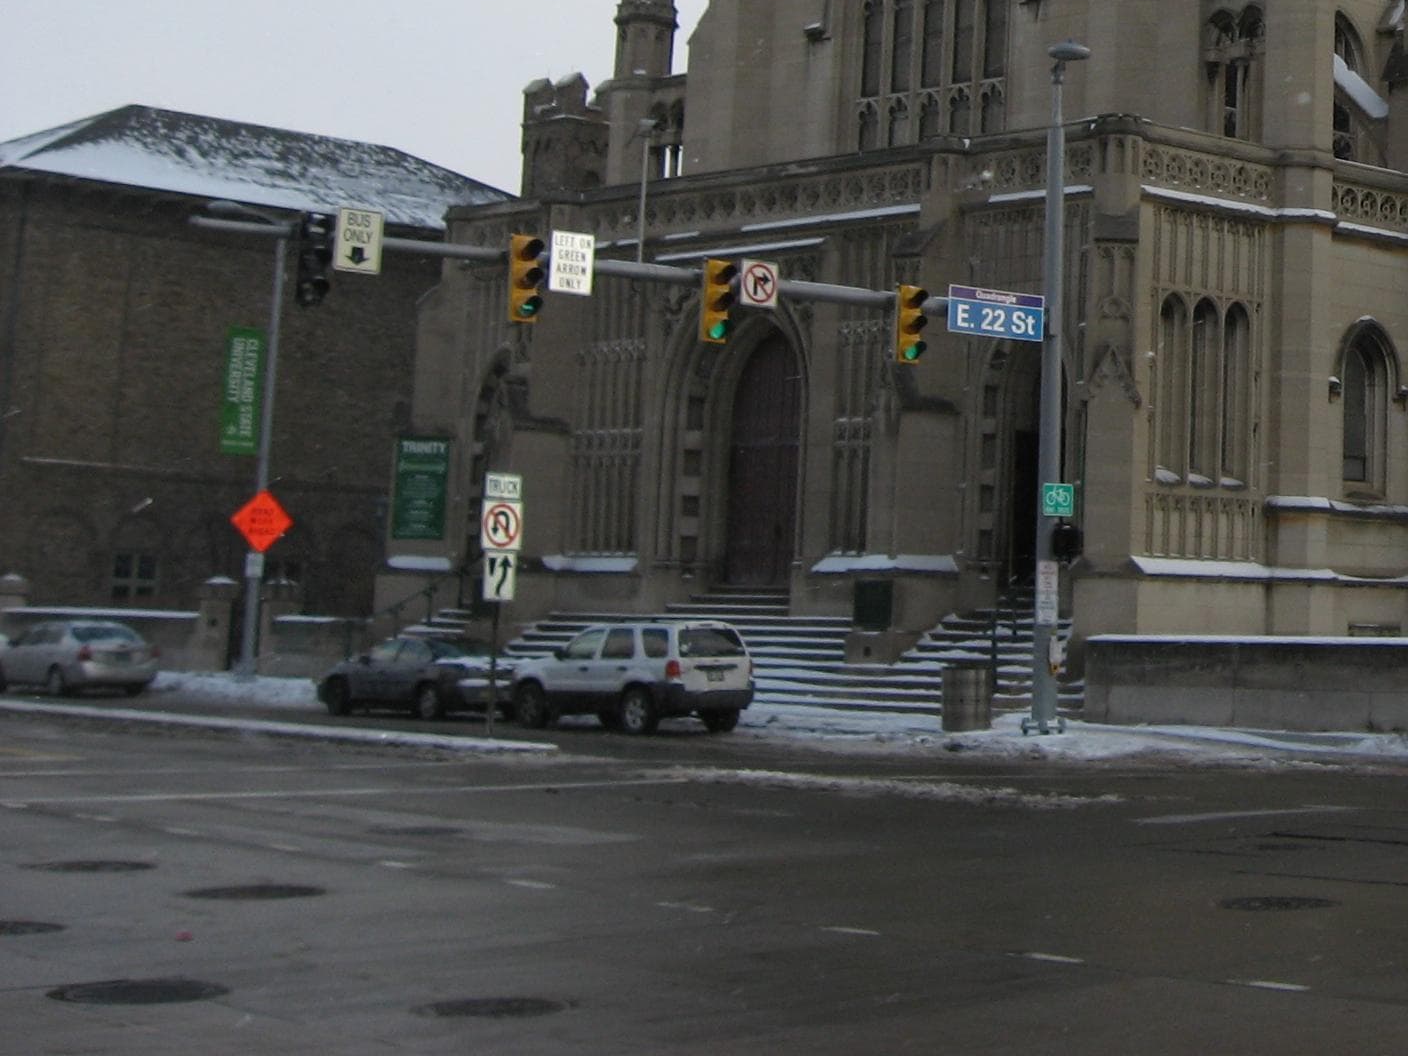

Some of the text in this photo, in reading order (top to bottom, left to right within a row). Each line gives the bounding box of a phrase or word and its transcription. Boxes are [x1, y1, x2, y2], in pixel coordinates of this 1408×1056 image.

[347, 212, 371, 228] BUS
[343, 228, 374, 244] ONLY
[555, 234, 591, 249] LEFT ON
[559, 248, 586, 262] GREEN
[556, 263, 587, 275] ARROW
[559, 277, 581, 289] ONLY
[975, 290, 1017, 304] Quadrangle
[957, 304, 1036, 336] E. 22 St
[227, 337, 245, 403] UNIVERSITY
[240, 338, 259, 436] CLEVELAND STATE
[402, 440, 447, 454] TRINITY
[488, 479, 520, 495] TRUCK
